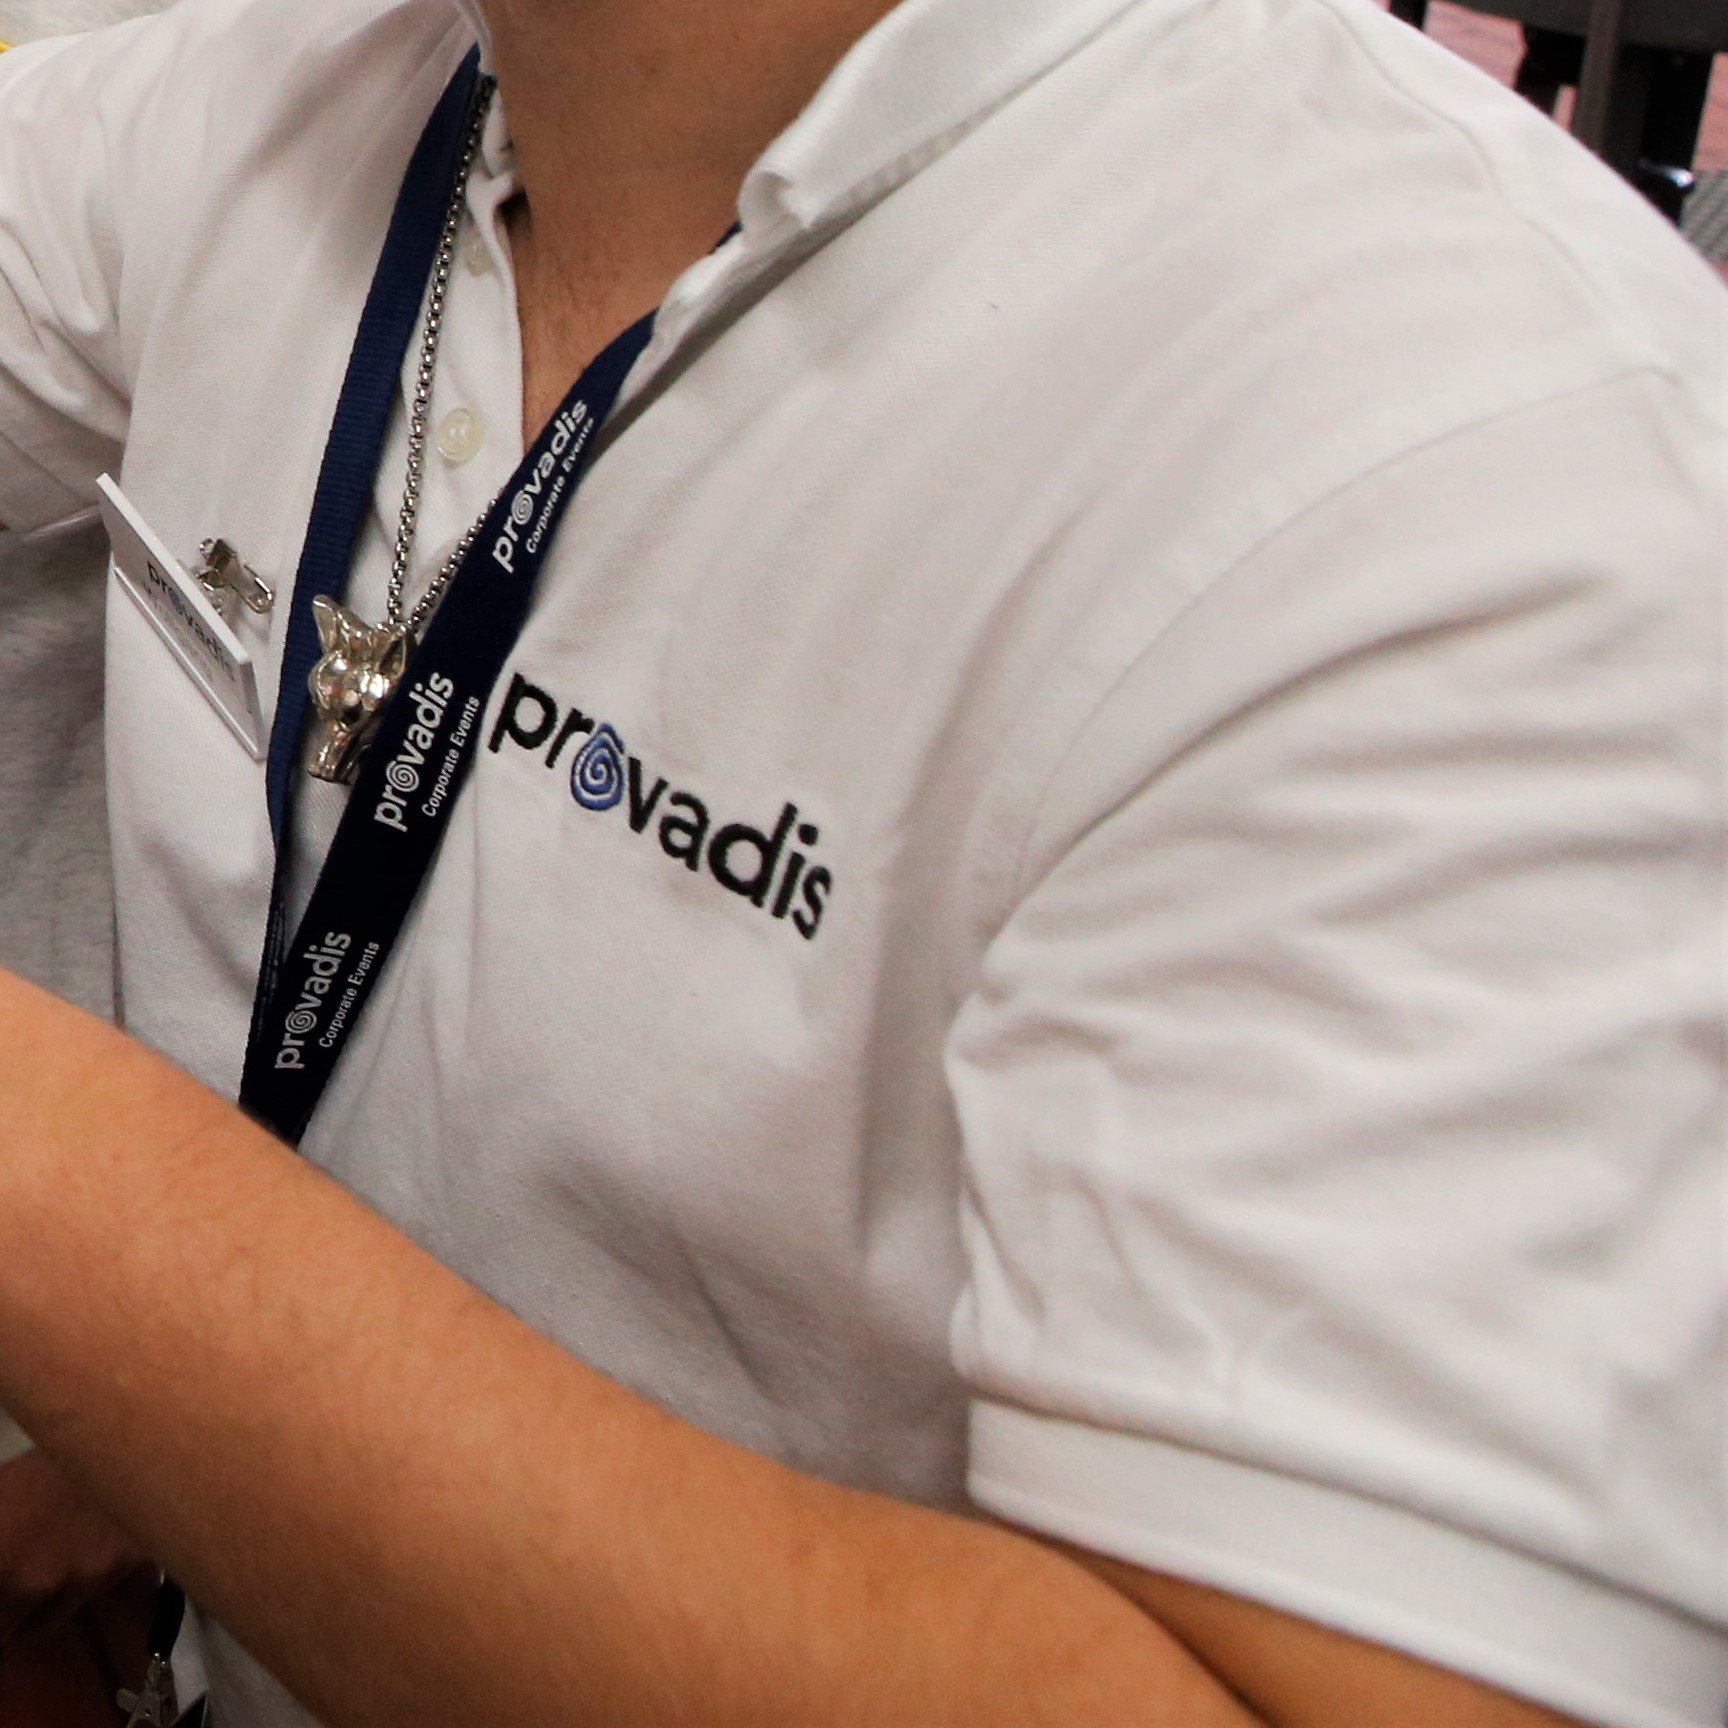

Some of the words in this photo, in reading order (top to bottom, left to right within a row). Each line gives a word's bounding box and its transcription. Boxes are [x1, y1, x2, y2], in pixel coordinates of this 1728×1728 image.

[492, 399, 587, 574] provadis
[525, 475, 565, 554] Corporate
[562, 418, 593, 472] Events
[374, 672, 454, 832] provadis
[421, 748, 459, 817] Corporate
[450, 696, 480, 748] Events
[488, 672, 831, 940] provadis
[274, 931, 351, 1069] provadis
[318, 988, 357, 1048] Corporate
[348, 942, 380, 986] Events
